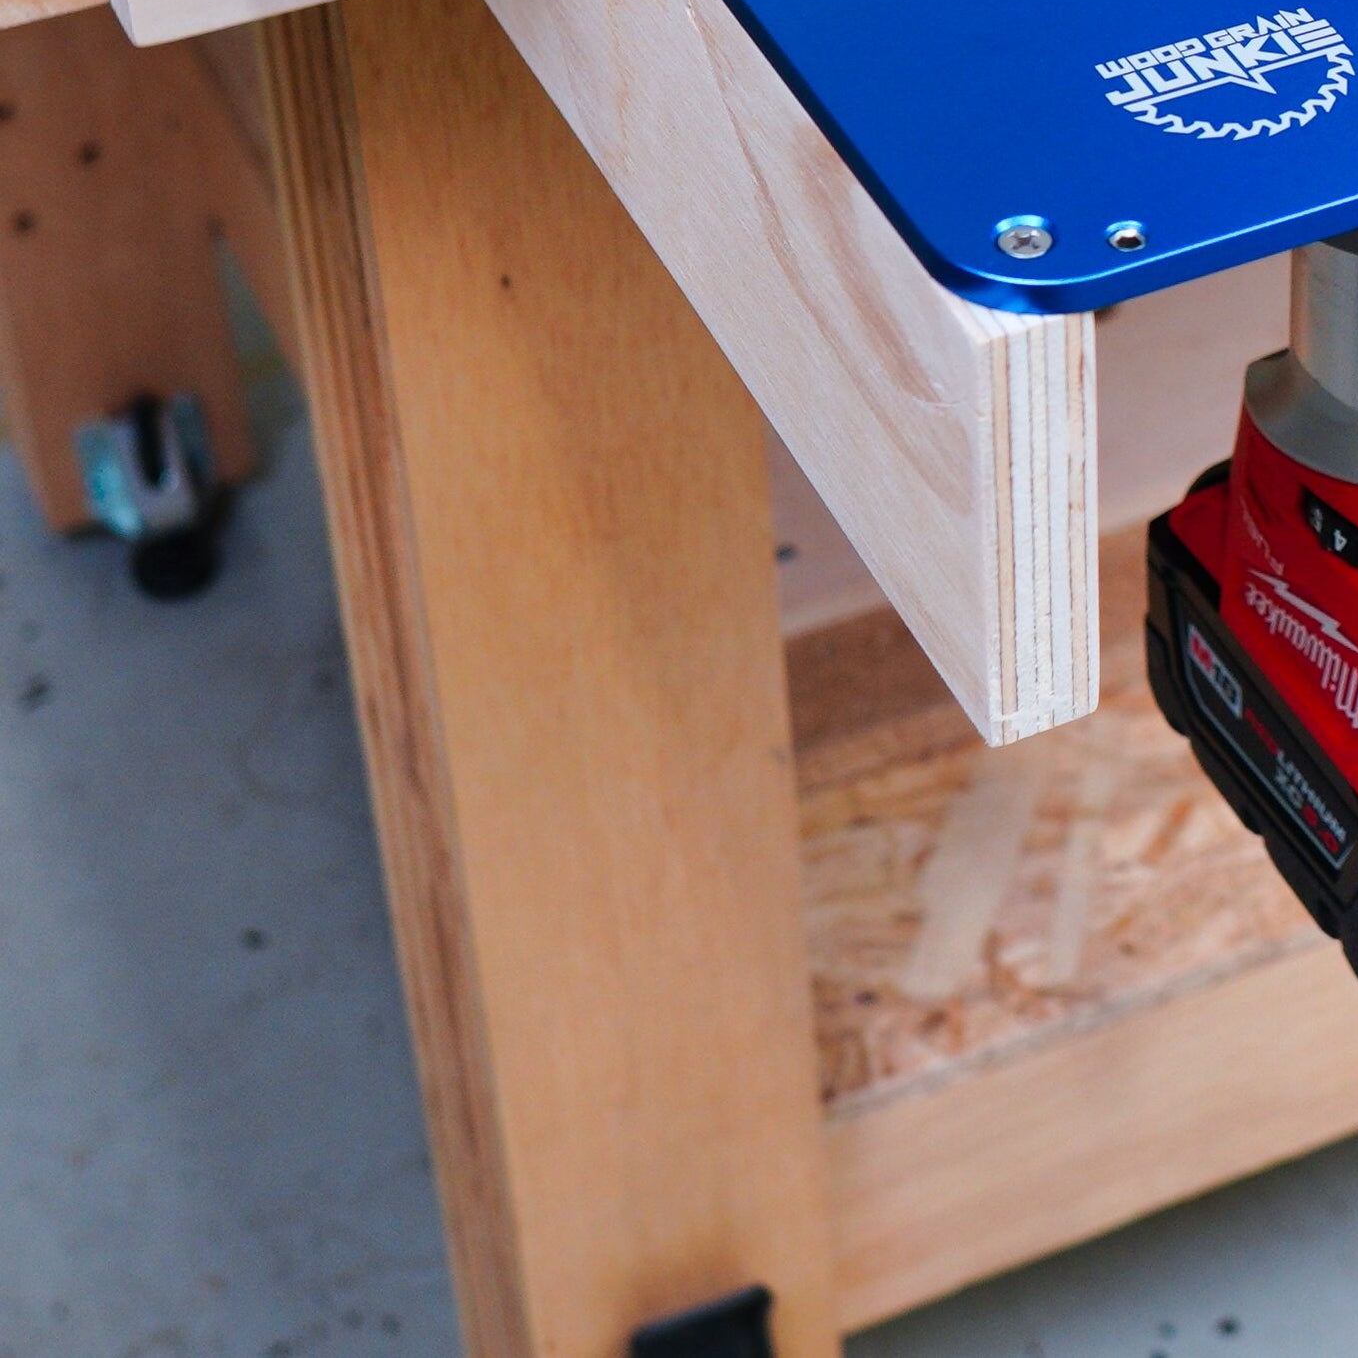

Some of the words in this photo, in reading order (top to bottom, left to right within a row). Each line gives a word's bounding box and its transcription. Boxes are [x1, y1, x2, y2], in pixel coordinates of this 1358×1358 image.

[1095, 37, 1206, 79] WOOD
[1203, 7, 1315, 50] GRAIN
[1104, 18, 1344, 106] JUNKIE
[1333, 528, 1348, 552] 4
